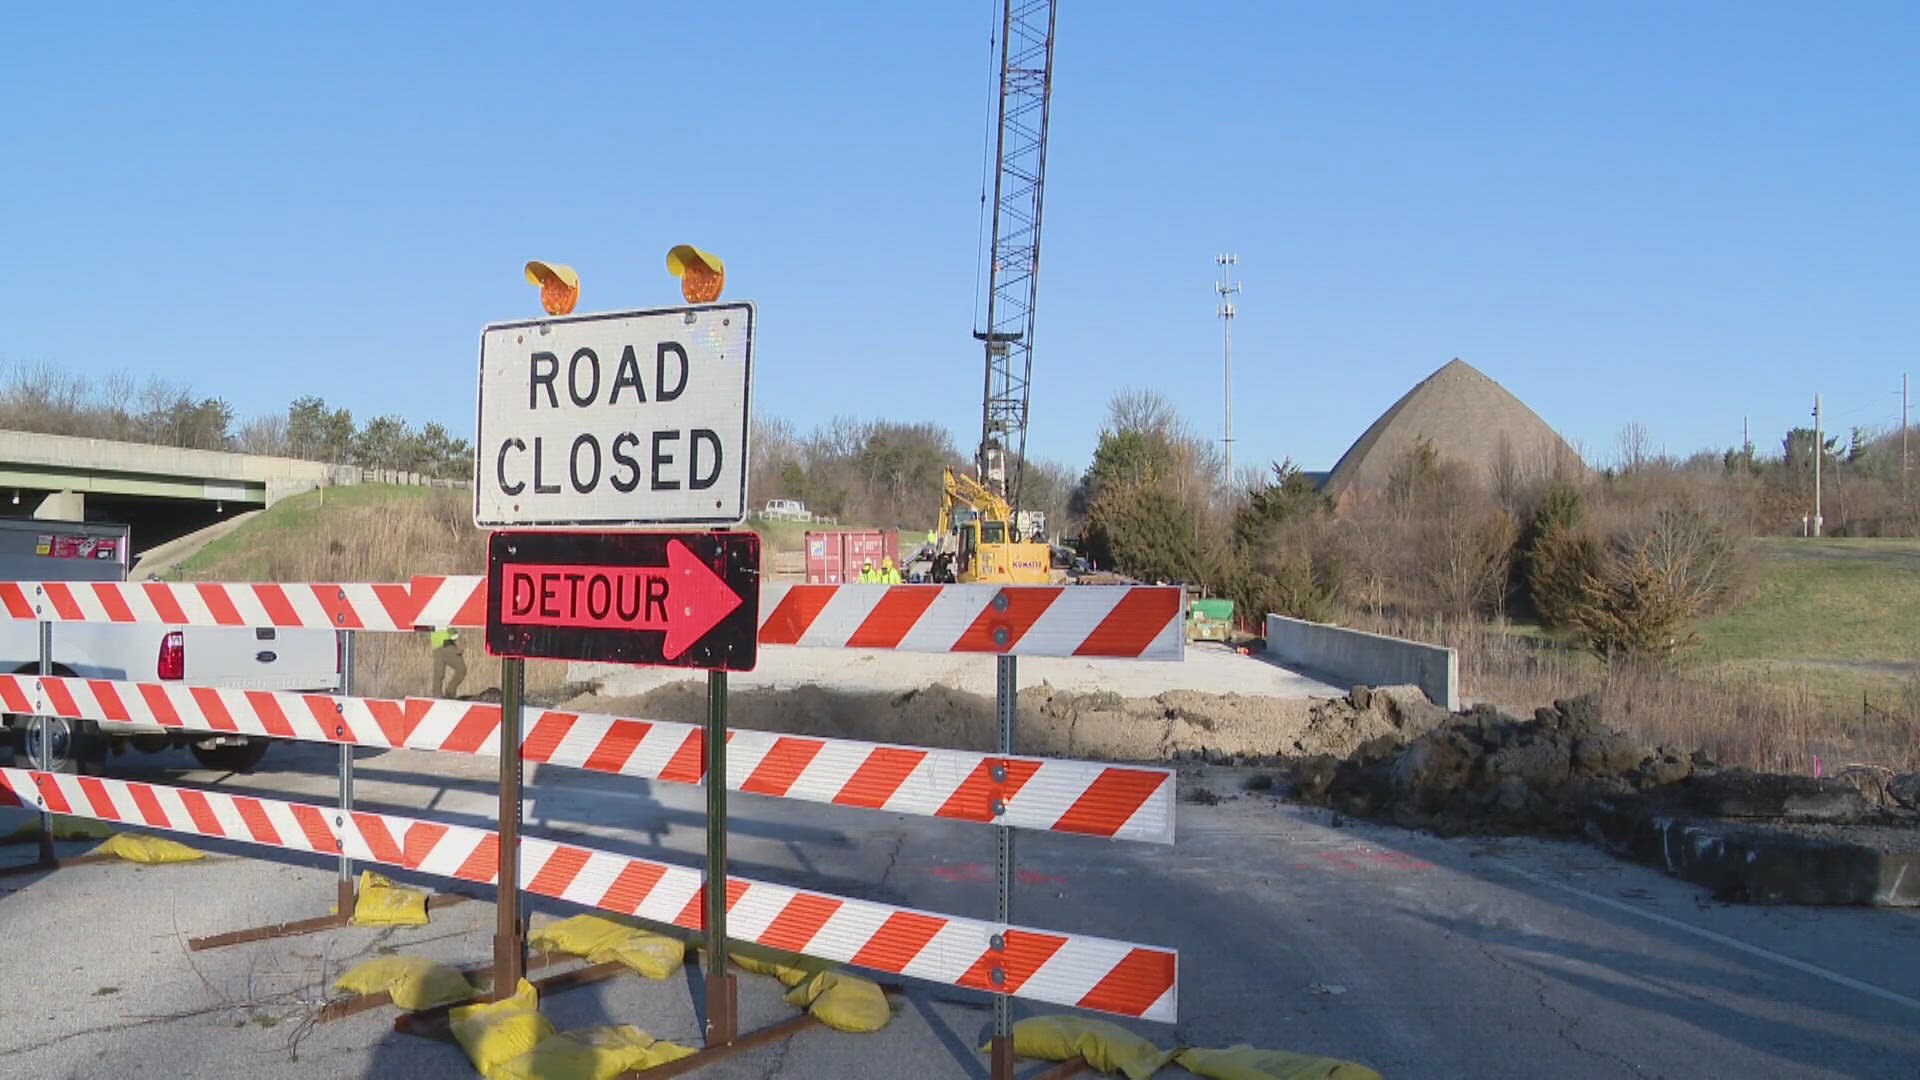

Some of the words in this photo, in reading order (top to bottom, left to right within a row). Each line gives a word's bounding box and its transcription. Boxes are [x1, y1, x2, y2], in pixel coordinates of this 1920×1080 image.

[529, 341, 689, 410] ROAD
[497, 429, 723, 496] CLOSED
[512, 572, 670, 623] DETOUR
